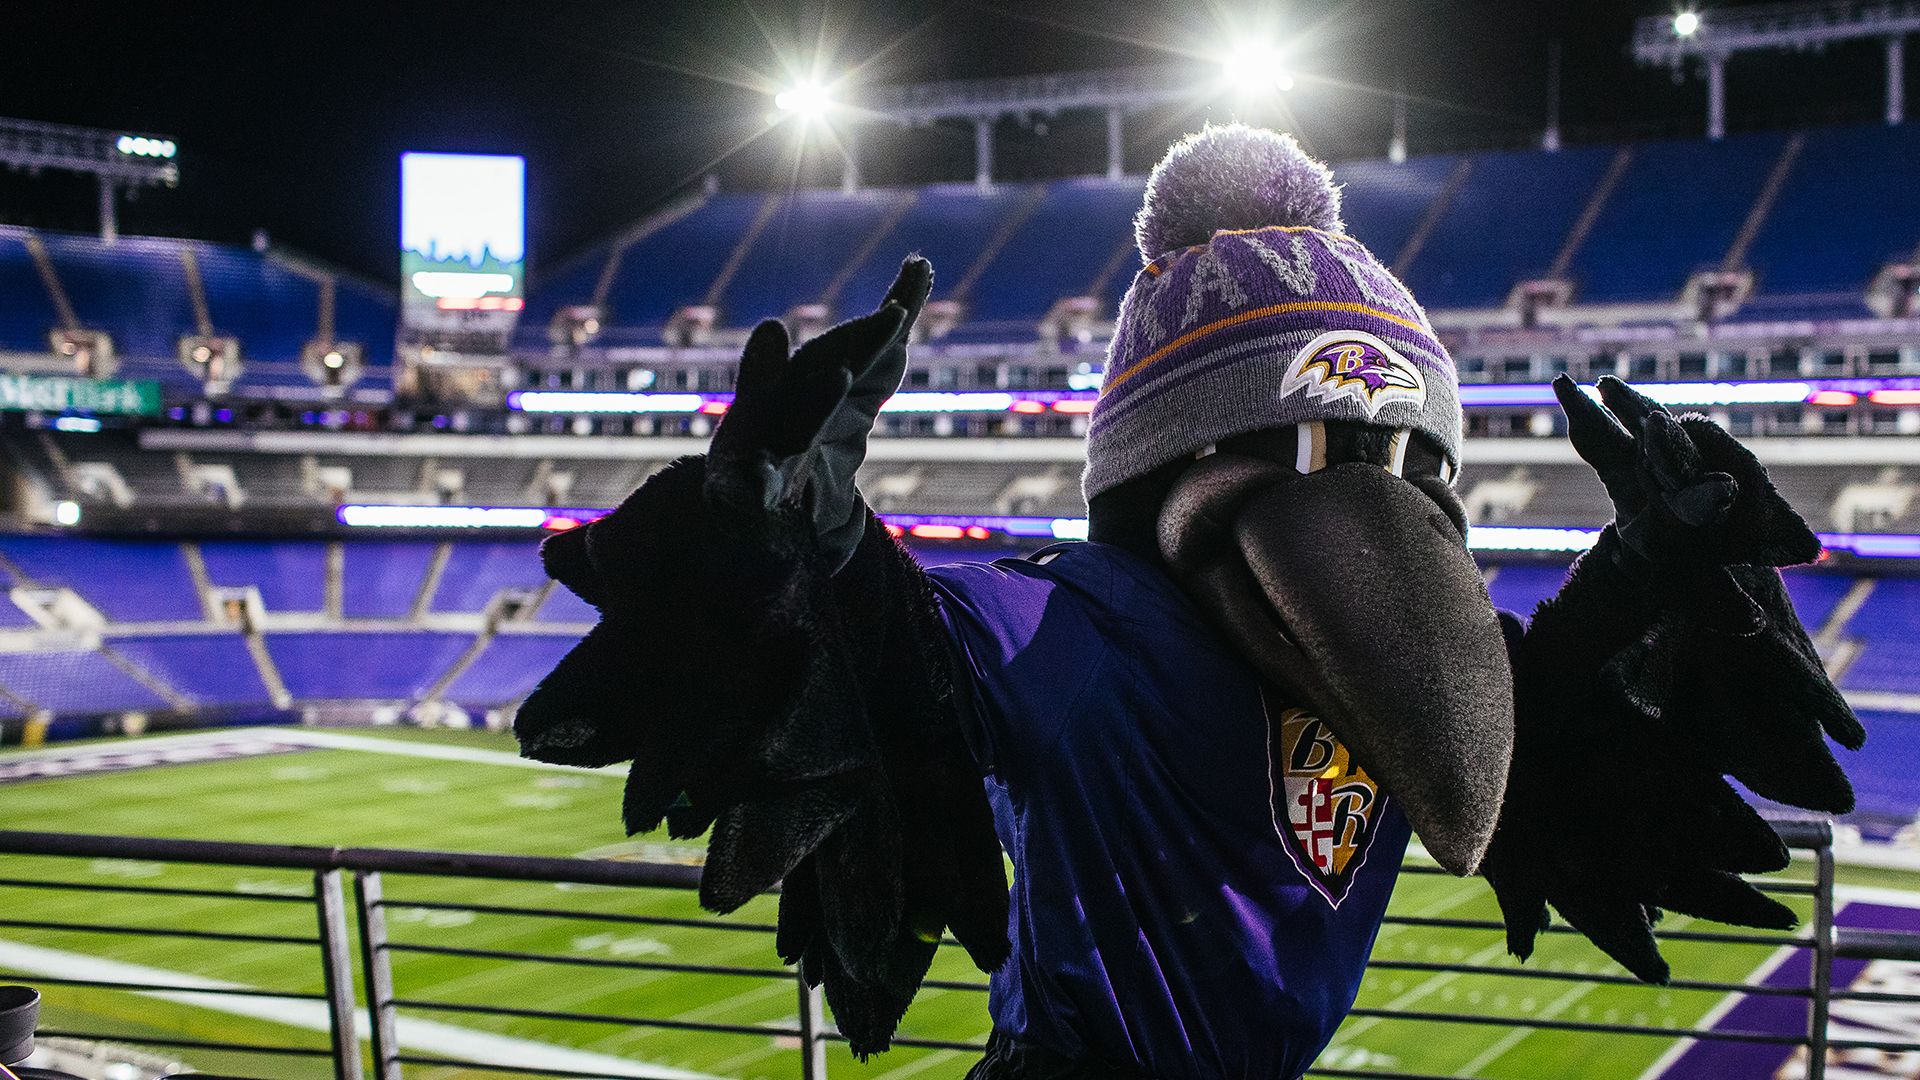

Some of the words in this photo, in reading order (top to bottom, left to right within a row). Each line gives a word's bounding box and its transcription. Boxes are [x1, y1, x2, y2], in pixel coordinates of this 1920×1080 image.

[1322, 344, 1366, 374] B
[1282, 711, 1335, 773] B
[1331, 781, 1375, 848] R
